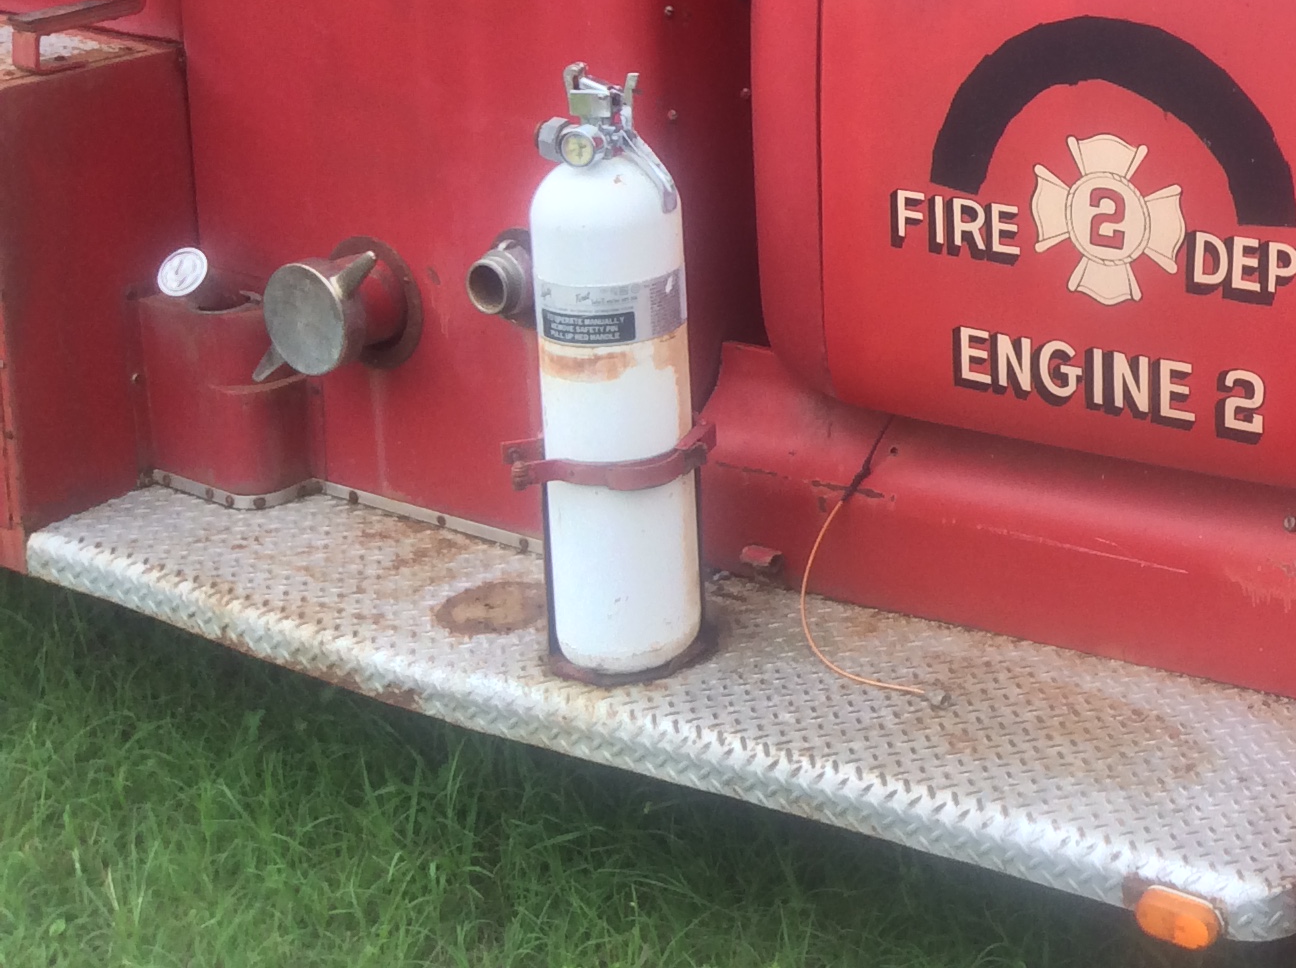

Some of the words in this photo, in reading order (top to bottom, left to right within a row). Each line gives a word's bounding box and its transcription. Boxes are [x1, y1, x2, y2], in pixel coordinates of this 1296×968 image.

[892, 188, 1021, 265] FIRE
[1088, 186, 1126, 250] 2
[953, 325, 1197, 429] ENGINE
[1216, 369, 1265, 444] 2
